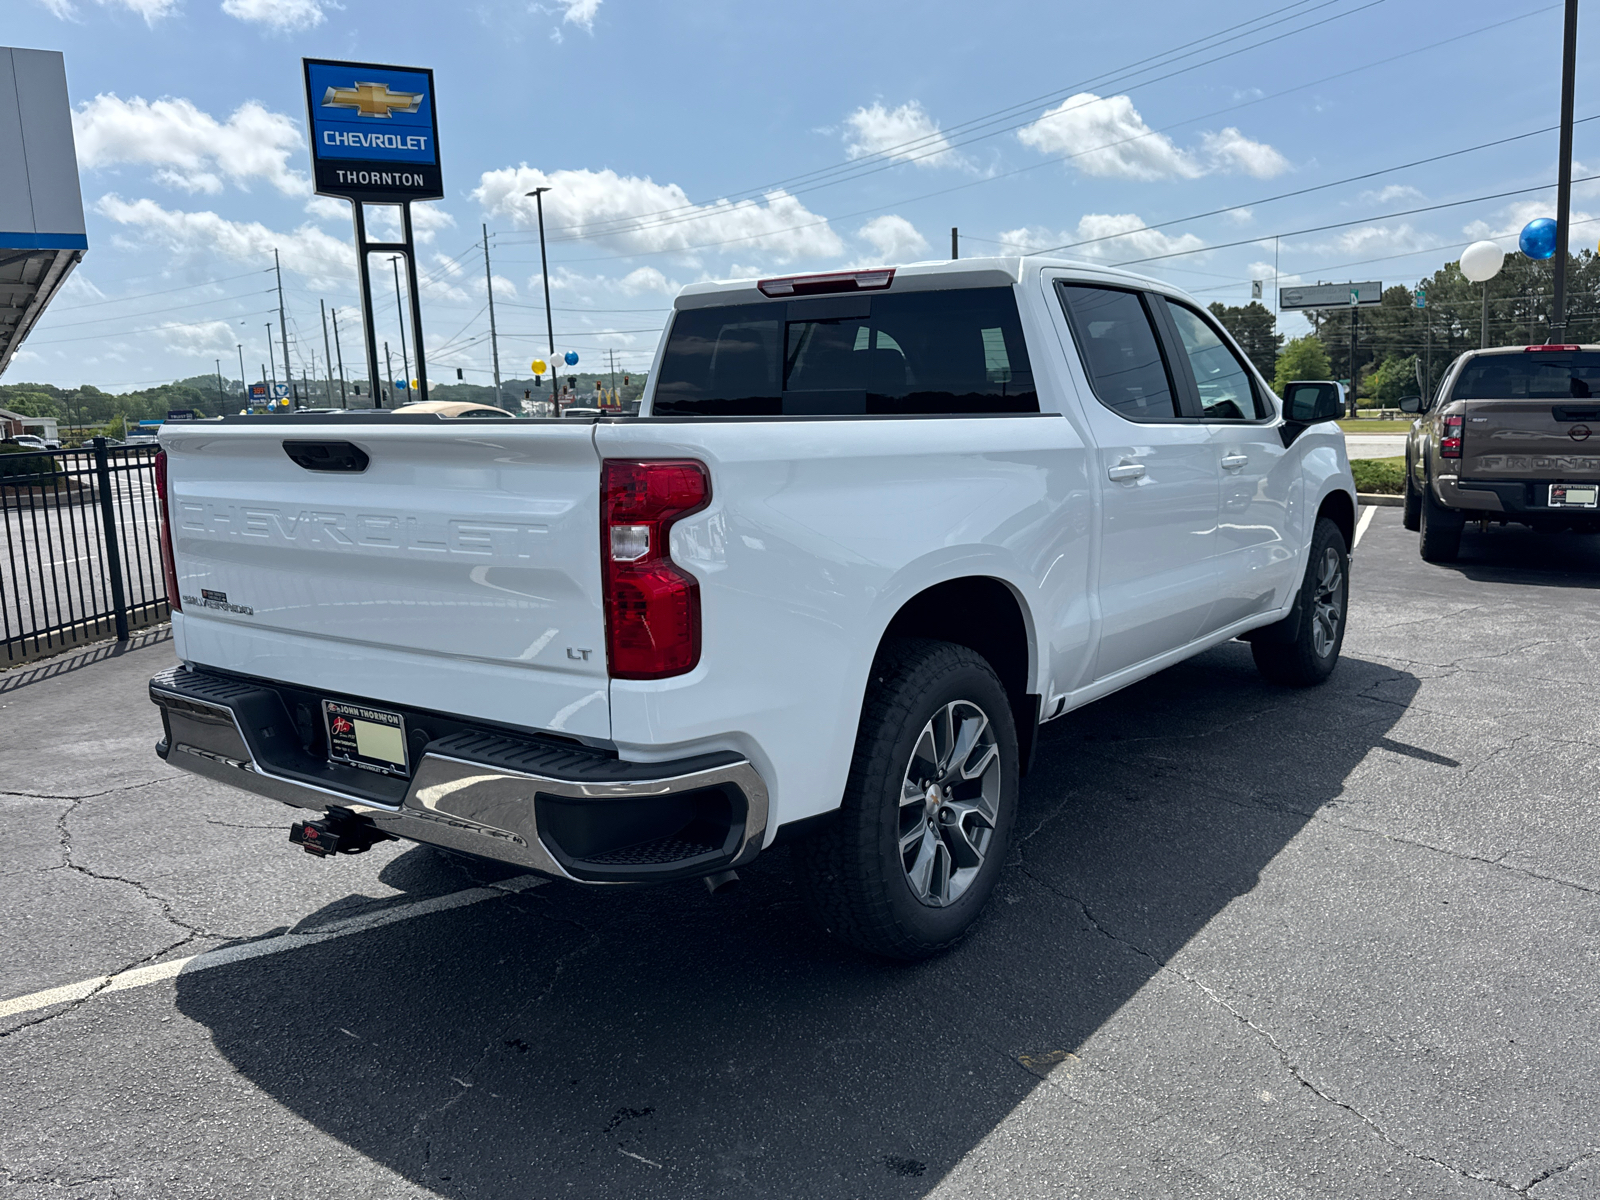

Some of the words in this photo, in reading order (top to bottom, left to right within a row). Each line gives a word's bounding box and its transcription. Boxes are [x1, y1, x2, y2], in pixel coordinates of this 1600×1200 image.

[323, 131, 428, 150] CHEVROLET
[336, 170, 424, 187] THORNTON
[179, 502, 549, 558] CHEVROLET
[182, 594, 254, 616] SILVERADO
[566, 647, 593, 661] LT
[340, 705, 359, 716] JOHN
[360, 709, 399, 724] THORNTON
